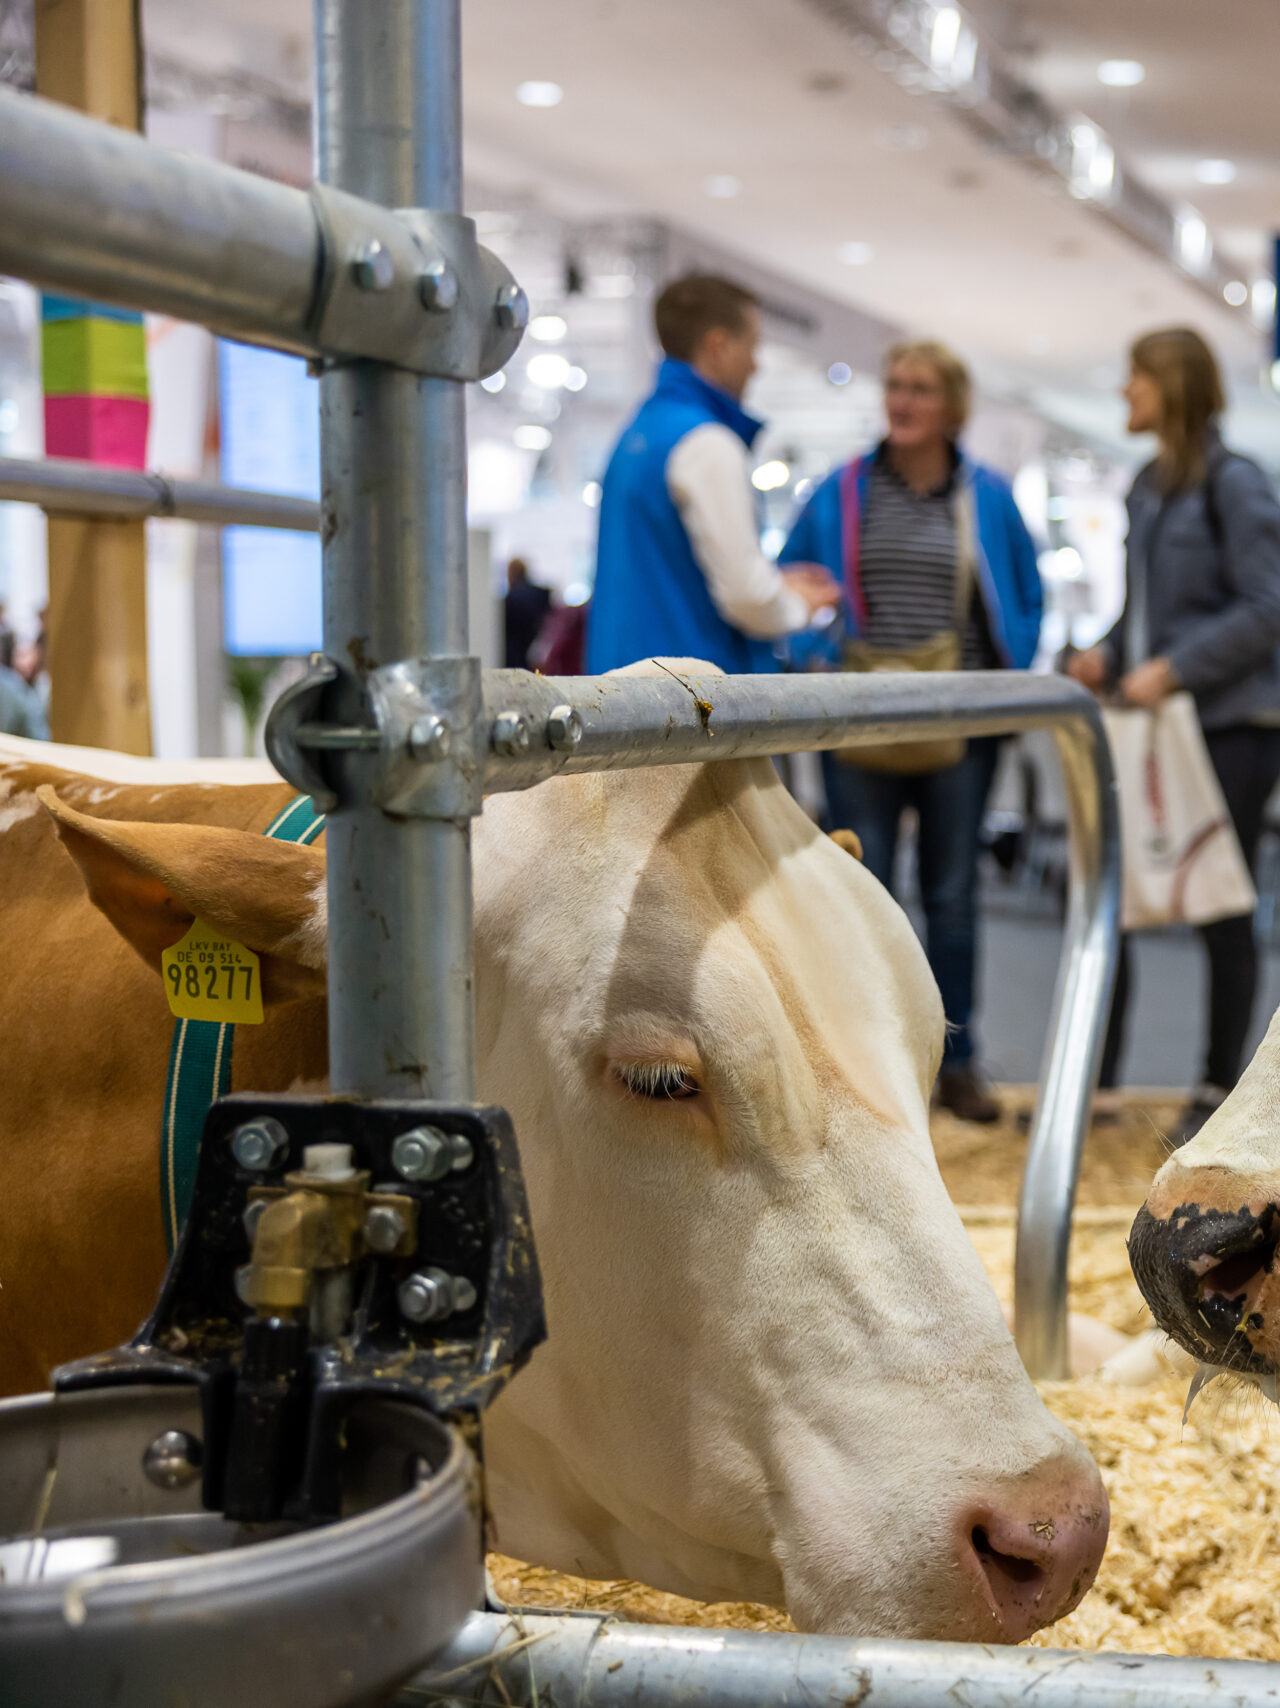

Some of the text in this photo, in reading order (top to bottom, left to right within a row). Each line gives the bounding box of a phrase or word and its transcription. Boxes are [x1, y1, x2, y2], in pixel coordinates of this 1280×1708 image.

[189, 941, 231, 952] LKV BAY
[177, 951, 242, 964] DE 09 514
[167, 963, 254, 1001] 98277
